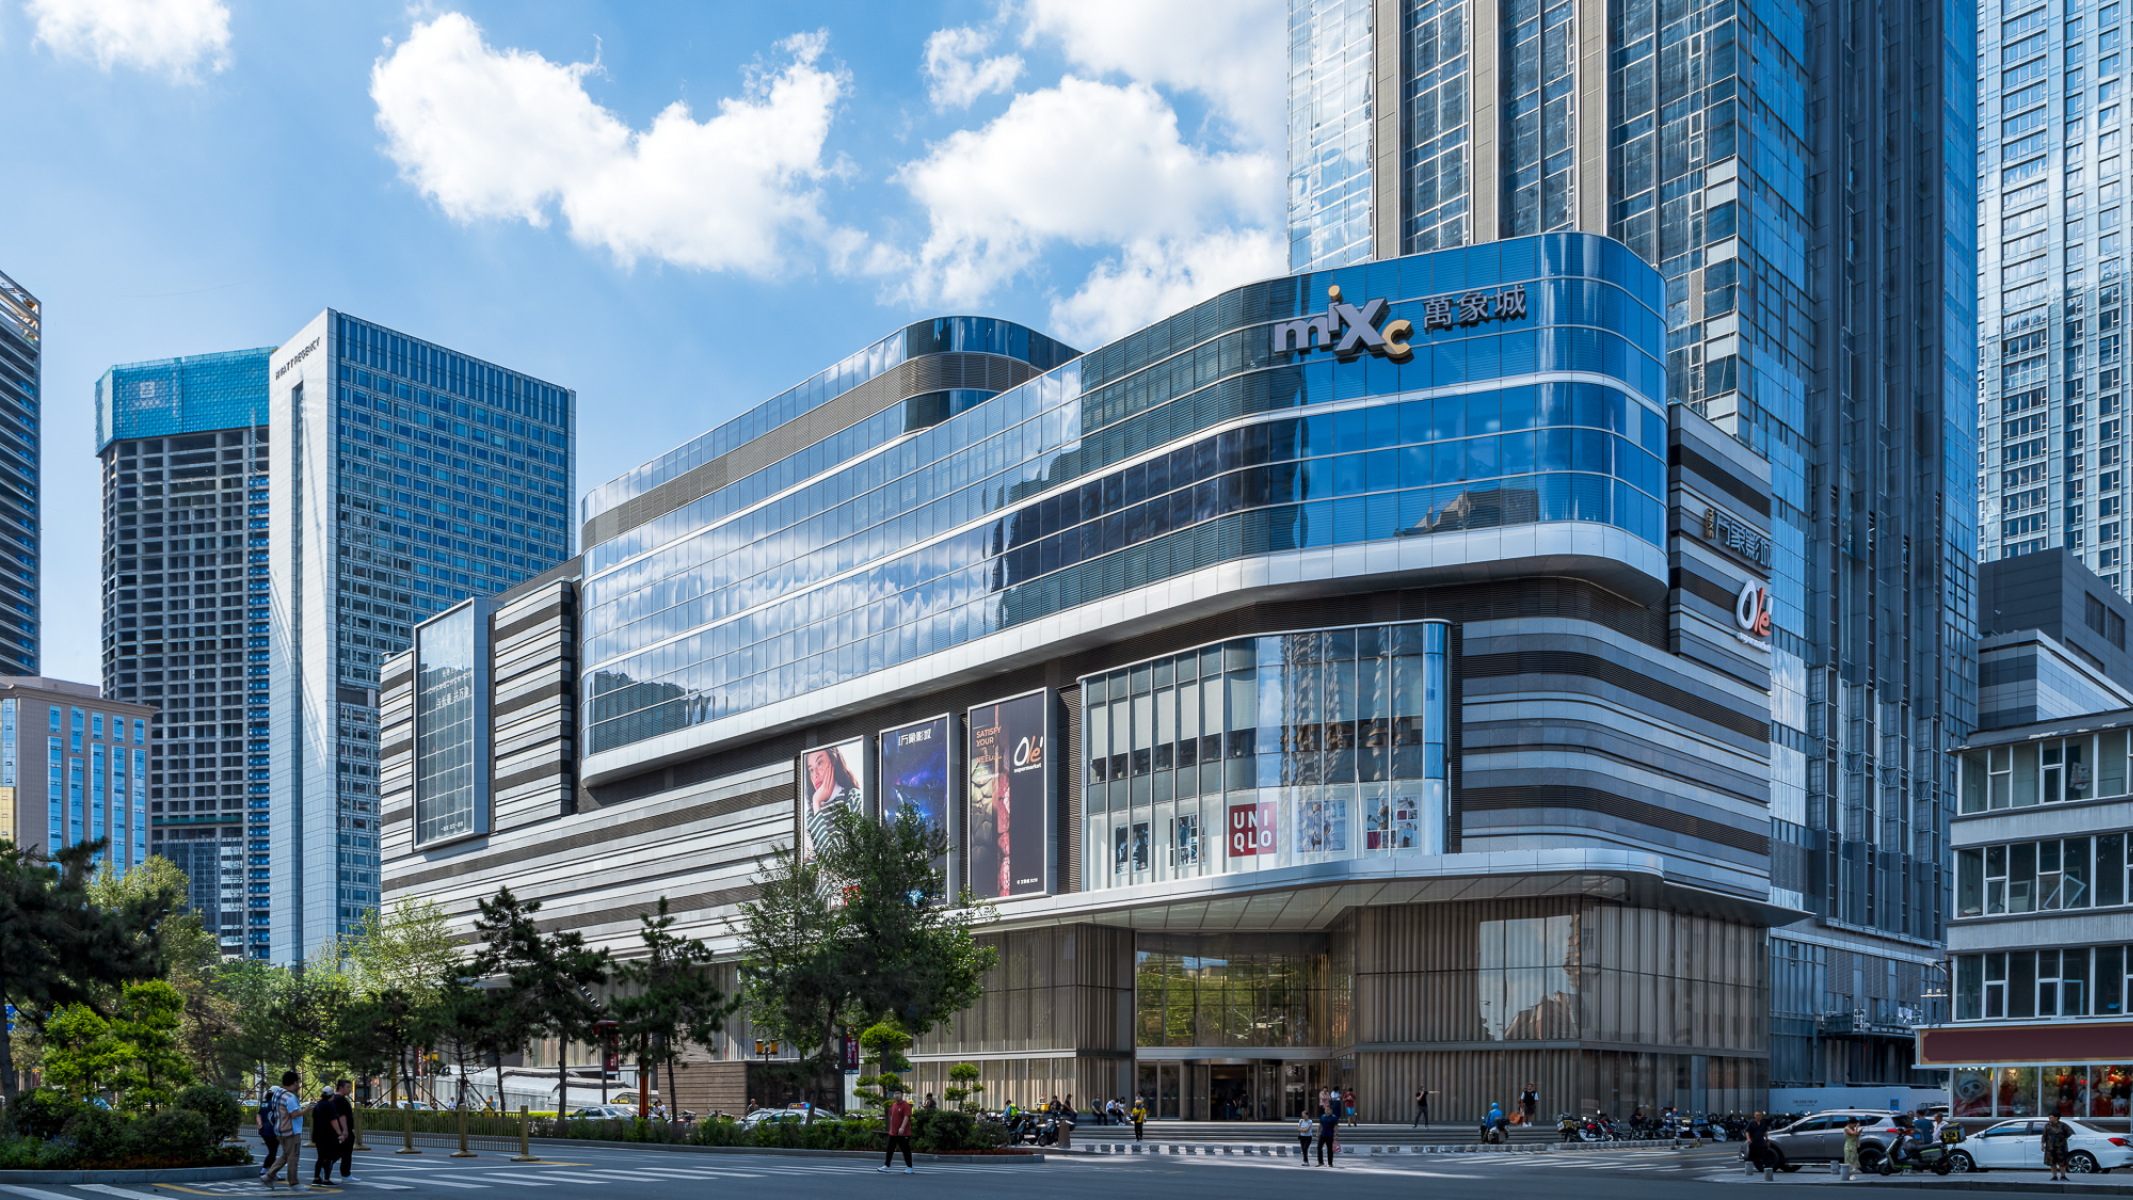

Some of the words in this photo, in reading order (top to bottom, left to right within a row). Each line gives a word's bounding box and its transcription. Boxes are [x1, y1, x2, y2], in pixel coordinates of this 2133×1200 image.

[1422, 284, 1527, 333] 萬象城
[976, 725, 1002, 739] SATISFY
[976, 736, 994, 748] YOUR
[1233, 809, 1269, 830] UNI
[1233, 830, 1272, 853] QLO
